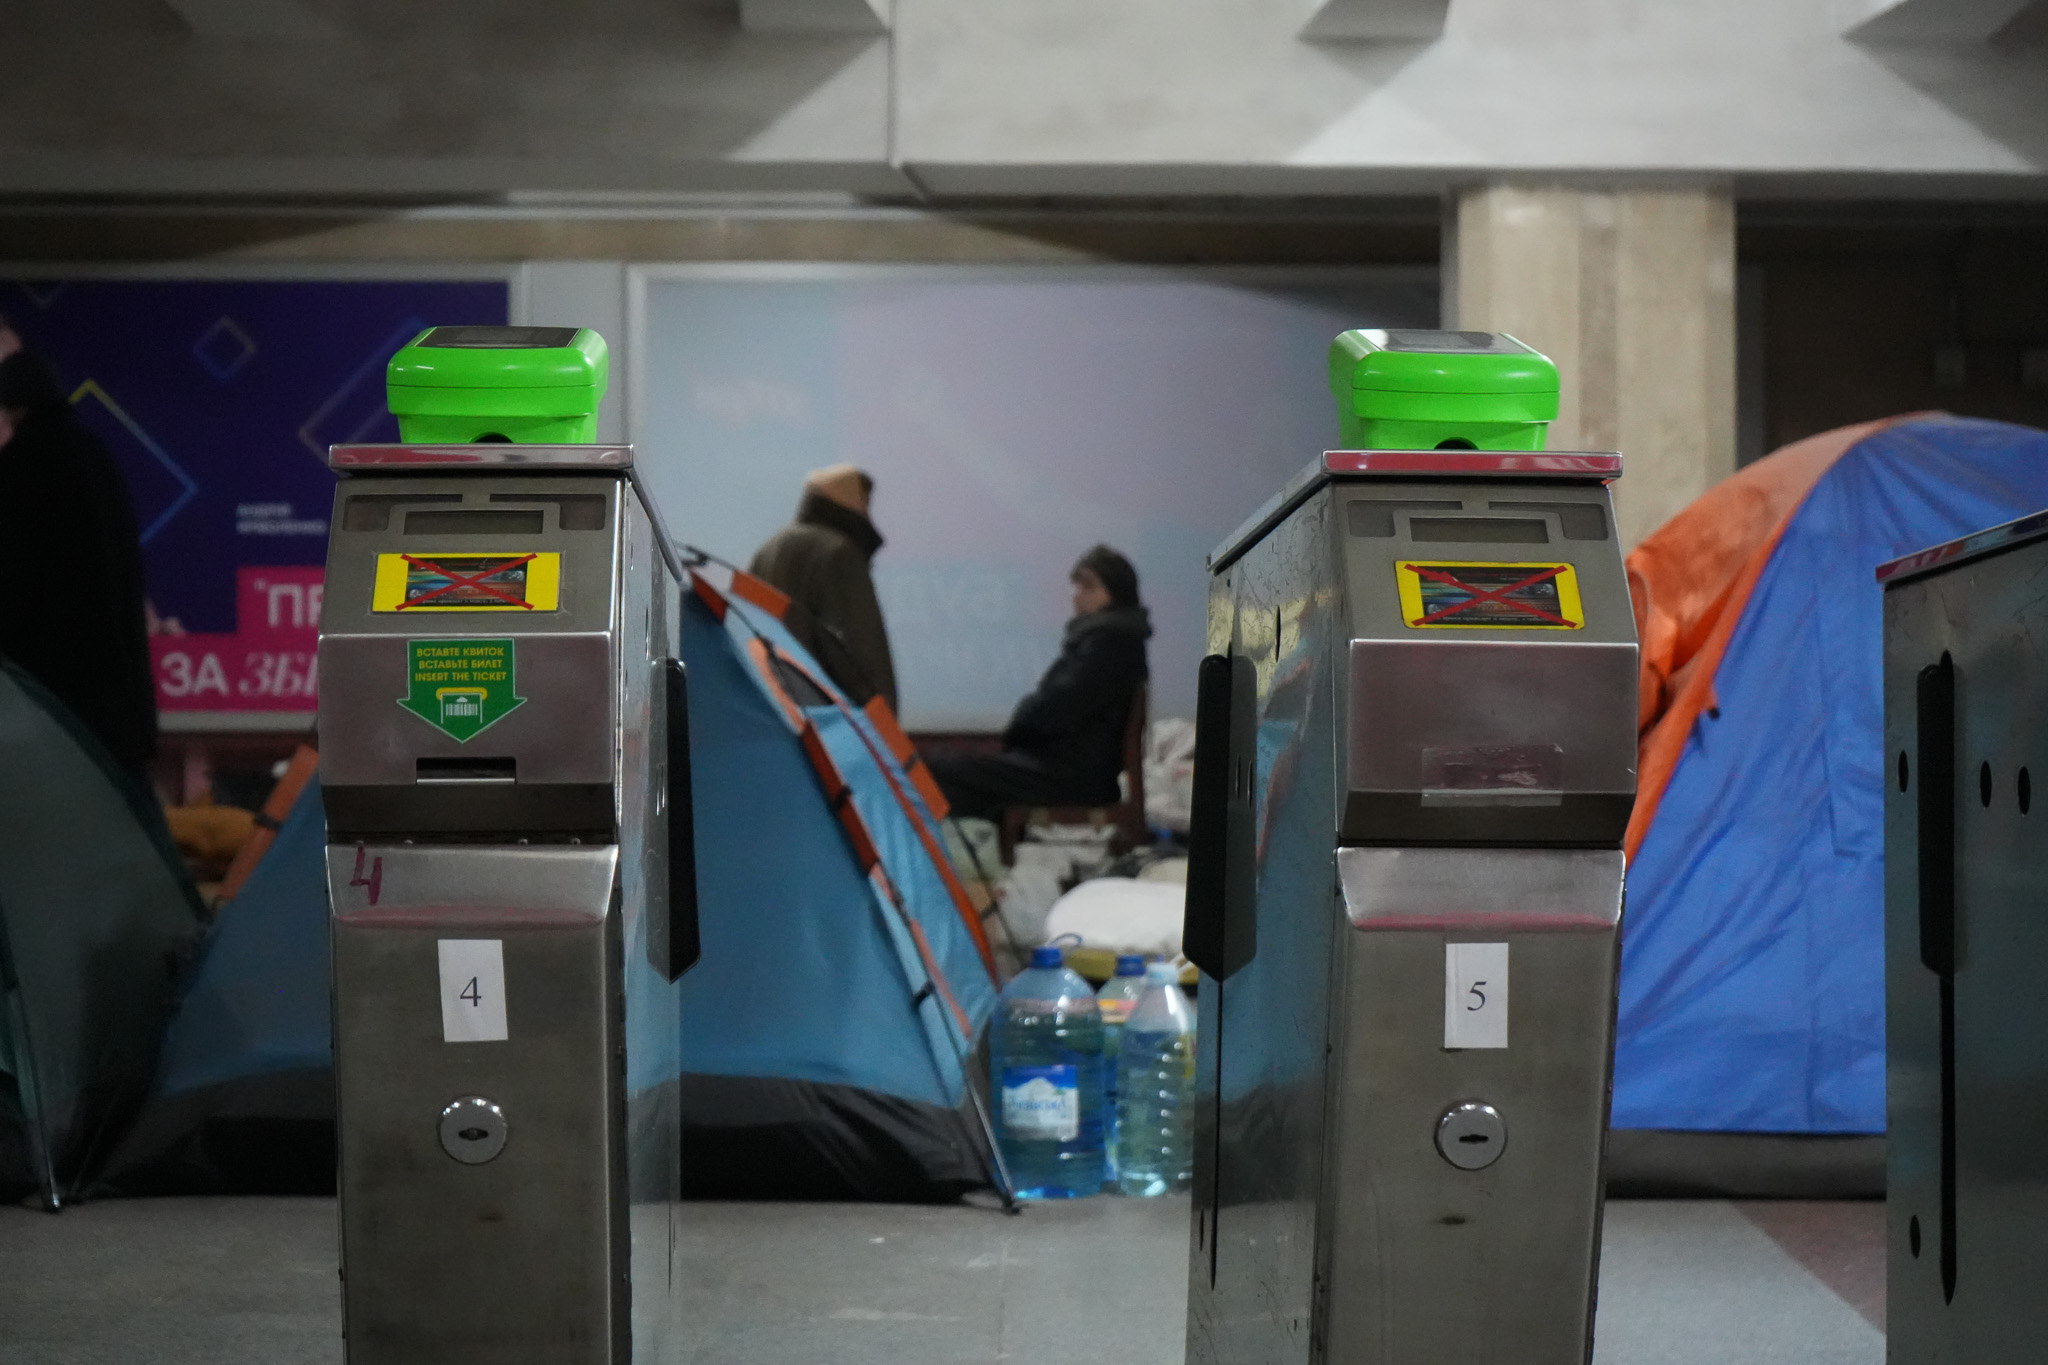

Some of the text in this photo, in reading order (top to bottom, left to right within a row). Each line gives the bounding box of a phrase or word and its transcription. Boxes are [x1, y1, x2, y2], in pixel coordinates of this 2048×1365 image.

[417, 647, 504, 657] ВСТАВТЕ КВИТОК
[419, 660, 502, 669] ВСТАВЬТЕ БИЛЕТ
[160, 651, 230, 697] ЗА
[415, 672, 506, 681] INSERT THE TICKET
[350, 846, 382, 906] 4
[459, 976, 482, 1007] 4
[1467, 981, 1487, 1011] 5
